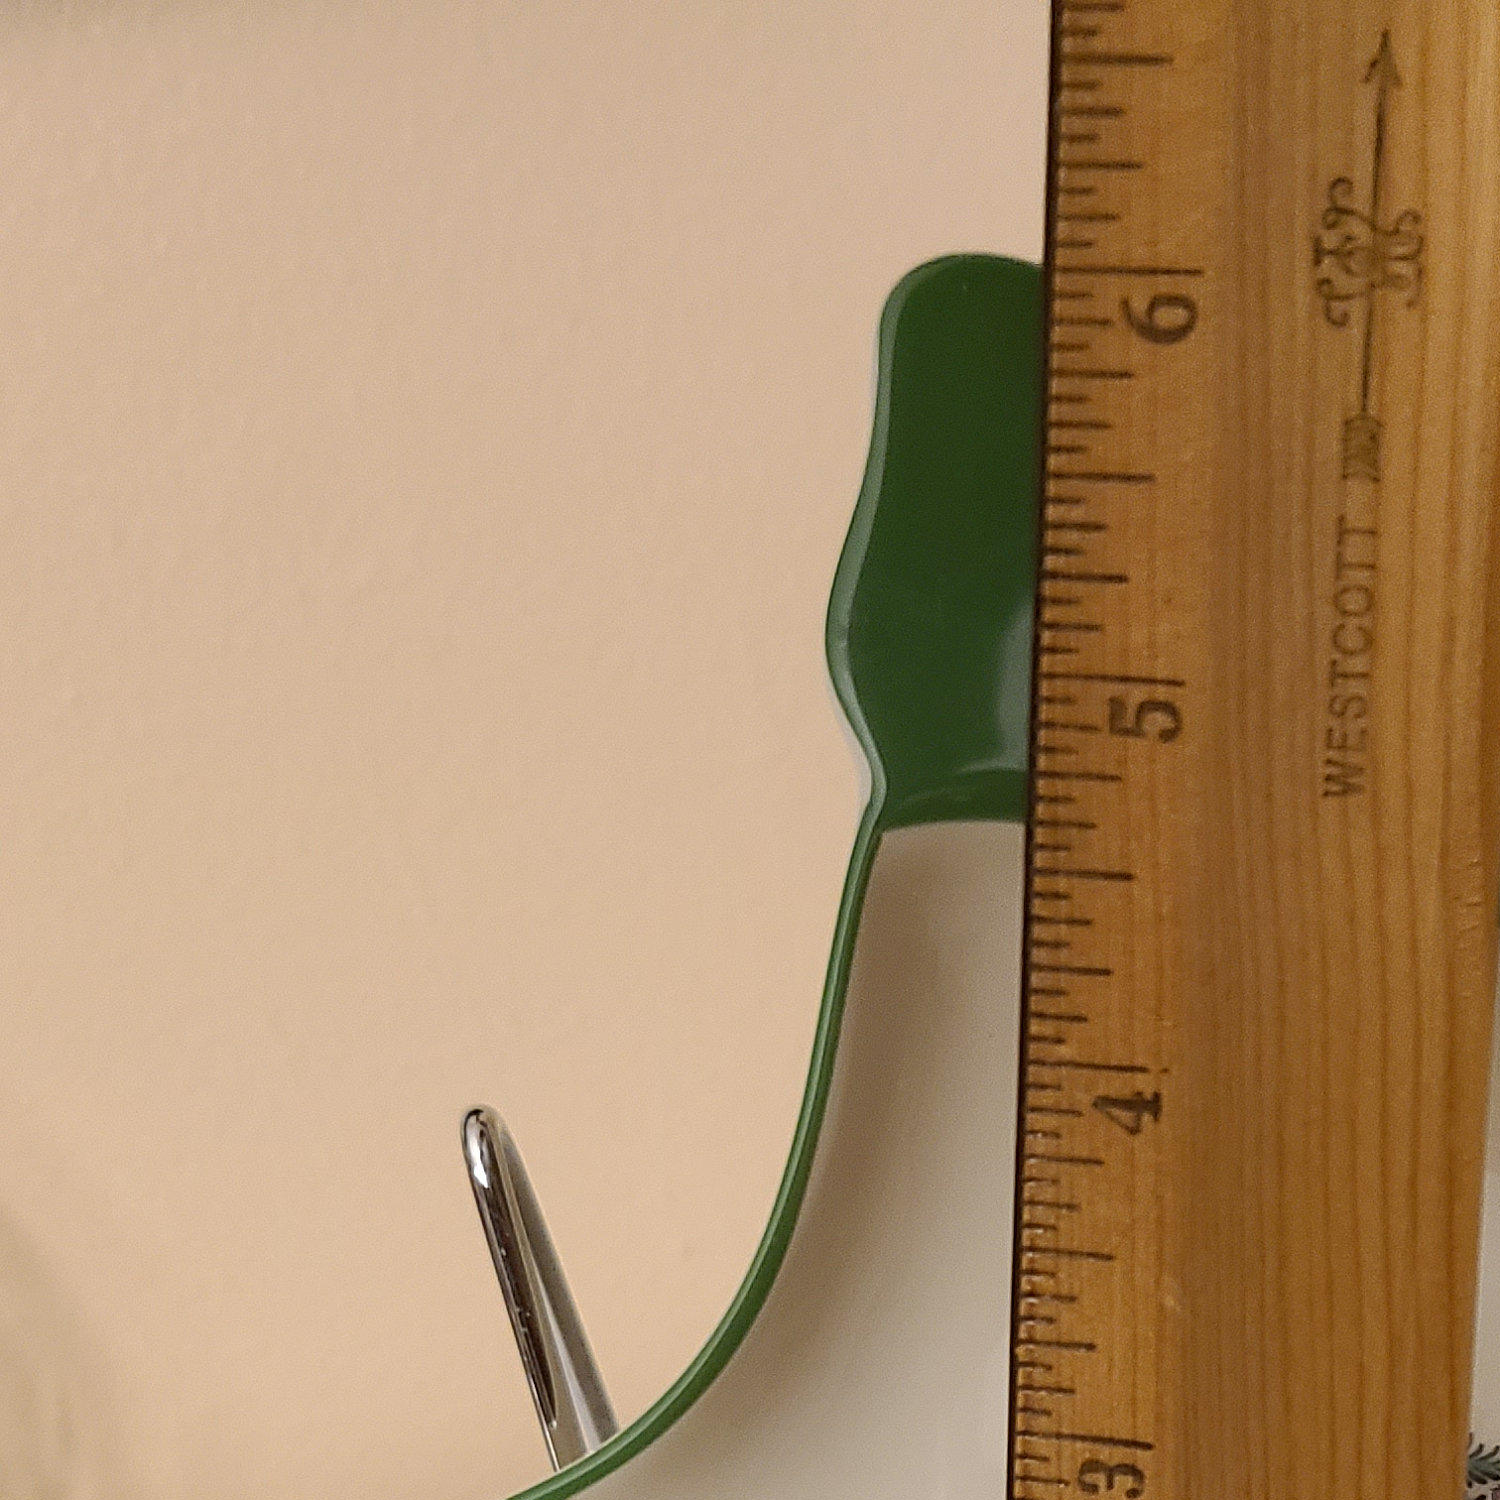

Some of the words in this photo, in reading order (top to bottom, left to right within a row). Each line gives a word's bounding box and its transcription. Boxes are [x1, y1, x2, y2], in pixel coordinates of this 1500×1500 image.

[1121, 293, 1199, 345] 6
[1321, 516, 1379, 798] WESTCOTT
[1108, 696, 1184, 745] 5
[1092, 1090, 1163, 1136] 4
[1077, 1456, 1147, 1500] 3
